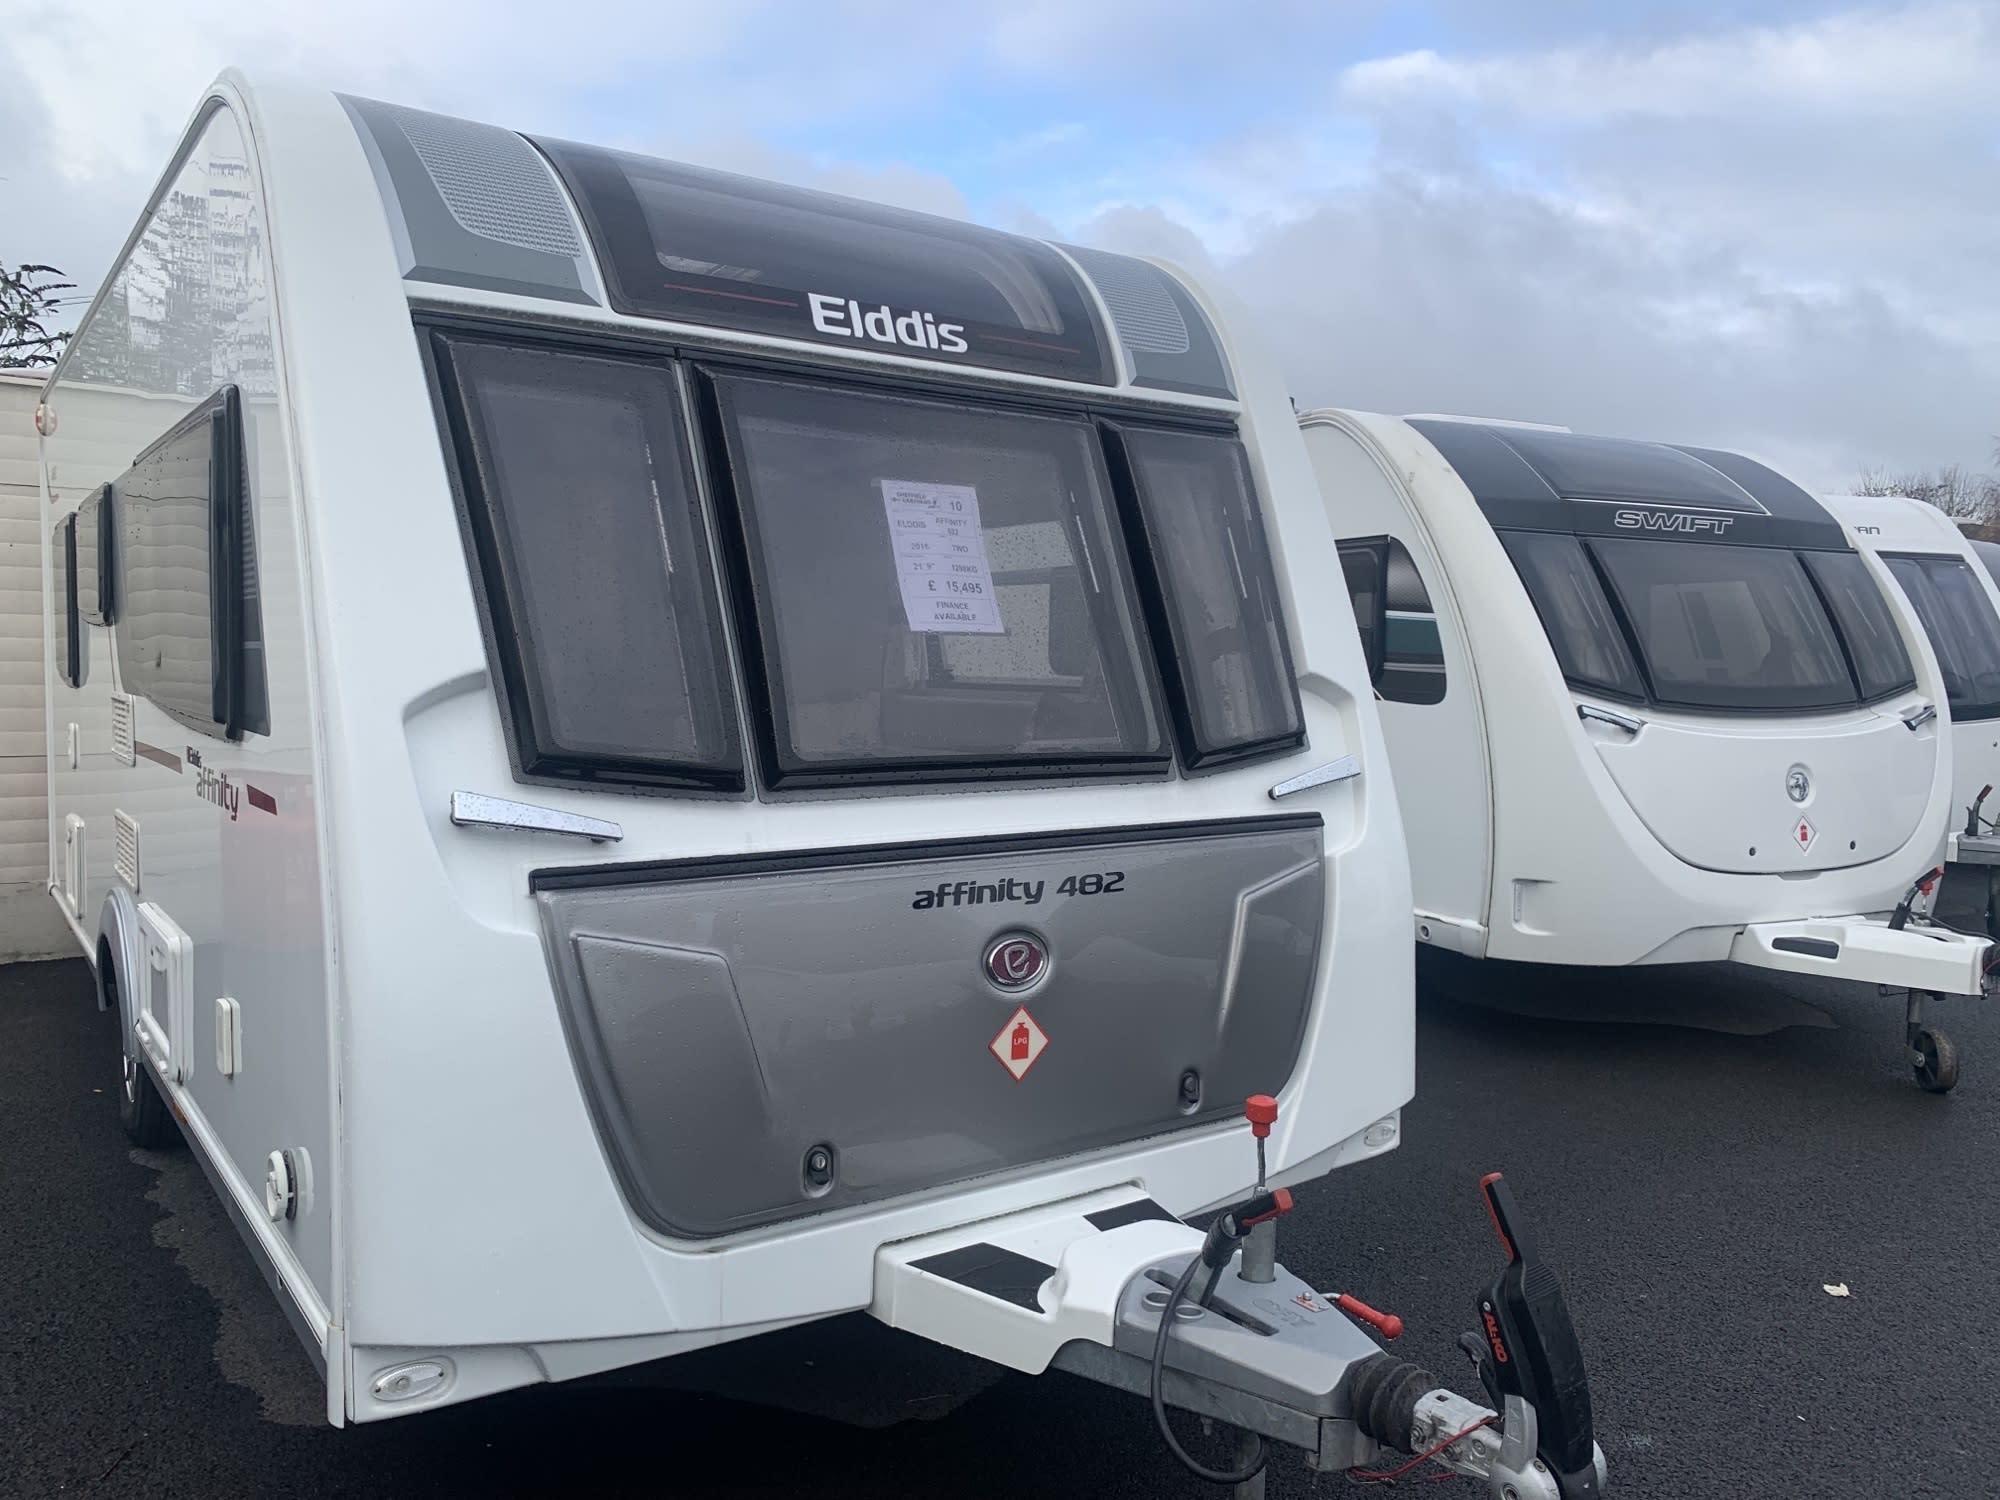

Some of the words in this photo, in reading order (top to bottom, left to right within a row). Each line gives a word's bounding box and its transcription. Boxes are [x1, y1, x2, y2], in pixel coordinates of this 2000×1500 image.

[807, 292, 968, 353] Elddis
[950, 500, 962, 512] 10
[1614, 510, 1734, 534] SWIFT
[951, 544, 969, 553] TWO
[928, 579, 937, 591] £
[946, 580, 983, 595] 15,495
[935, 601, 969, 610] FINANCE
[934, 613, 977, 621] AVAILABLE
[196, 766, 239, 822] affinity
[912, 877, 1045, 910] affinity
[1056, 871, 1126, 897] 482
[1013, 1037, 1028, 1046] LPG
